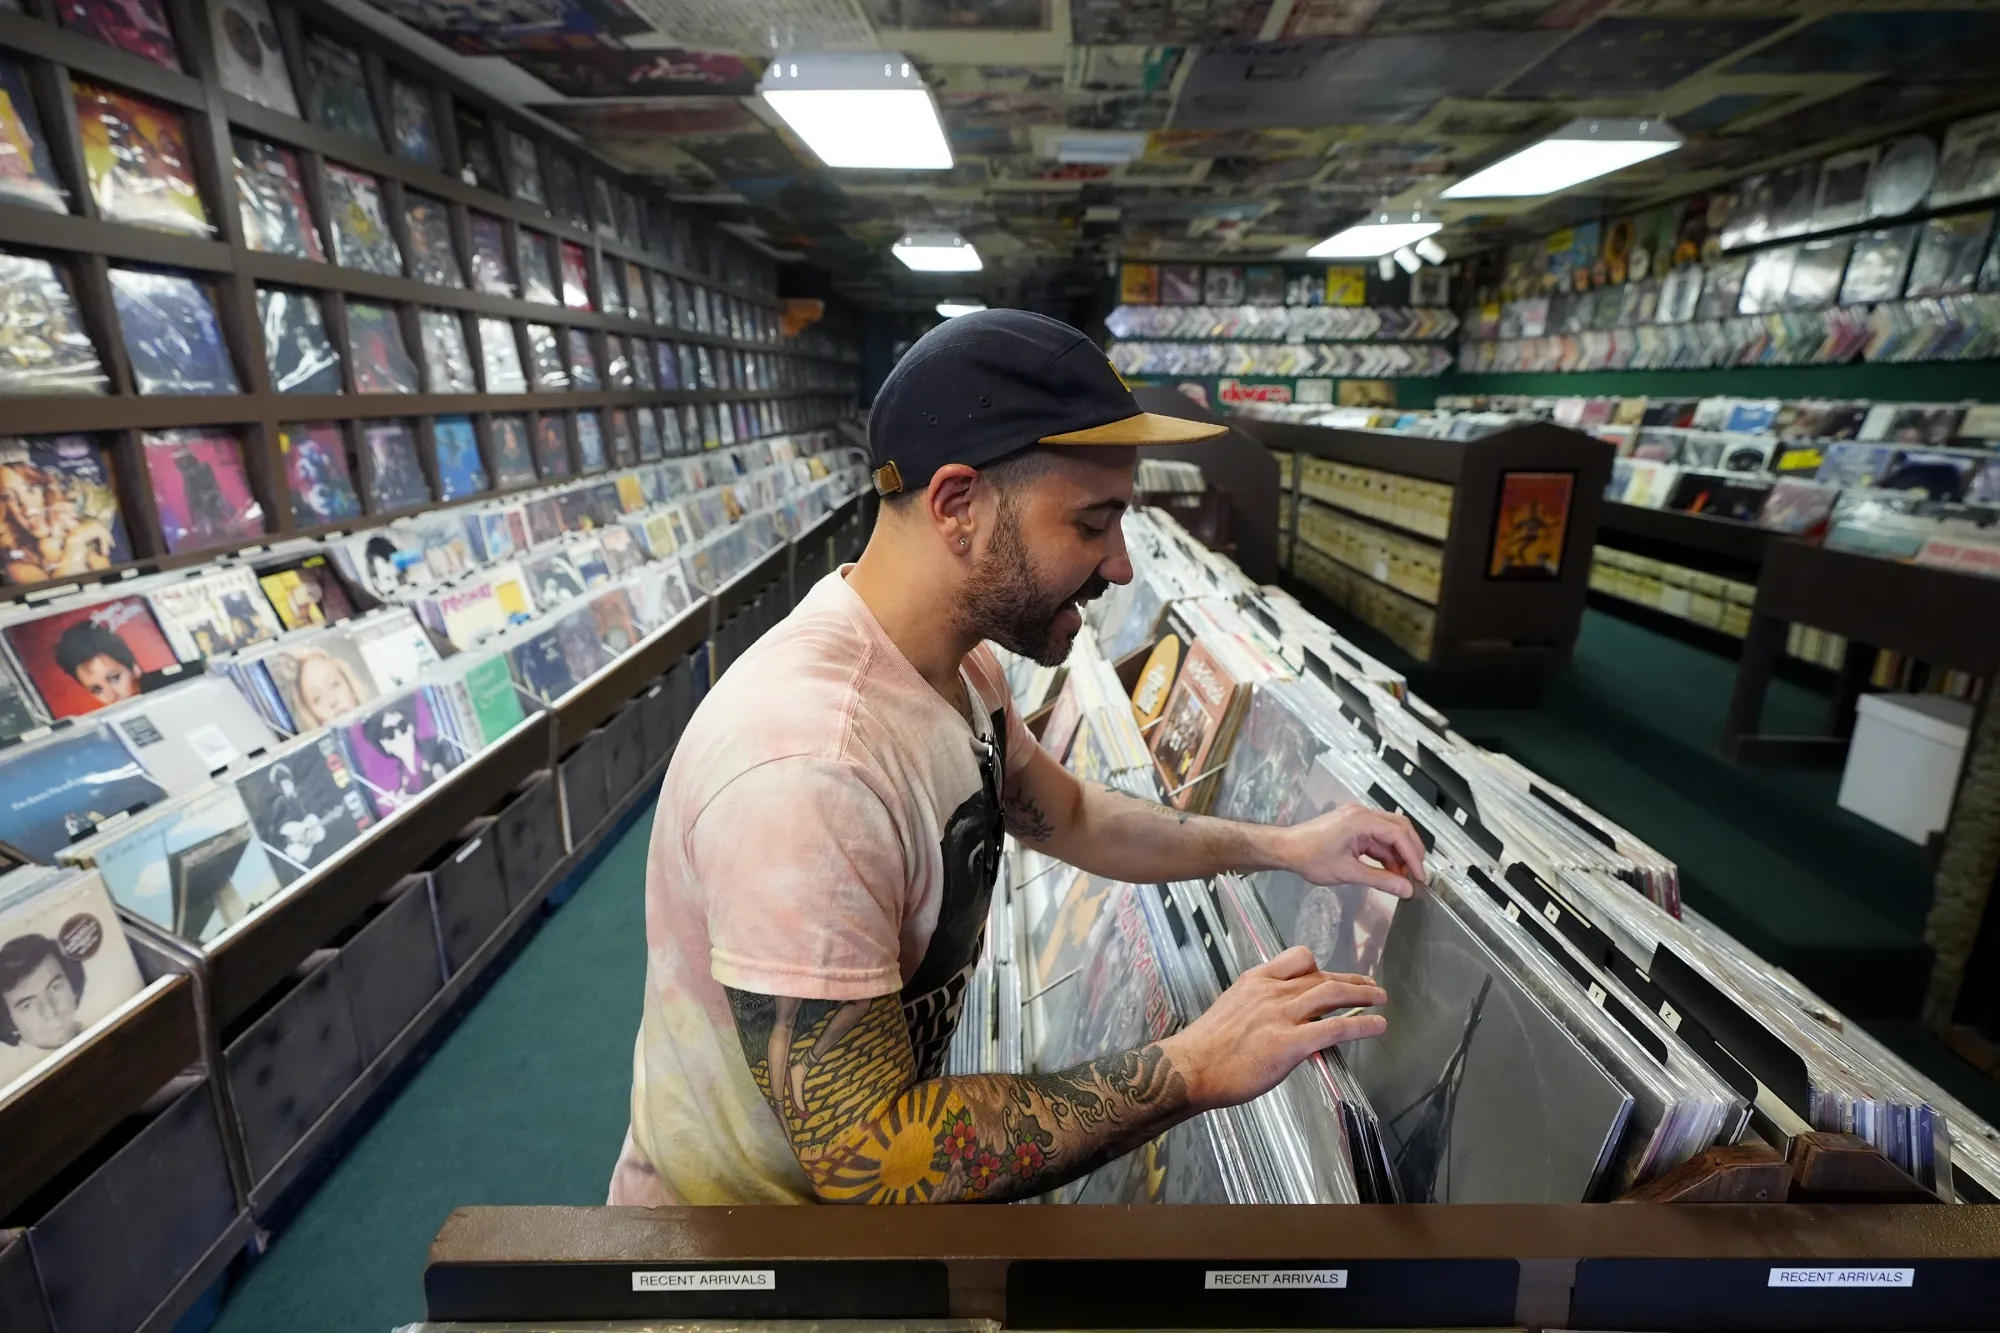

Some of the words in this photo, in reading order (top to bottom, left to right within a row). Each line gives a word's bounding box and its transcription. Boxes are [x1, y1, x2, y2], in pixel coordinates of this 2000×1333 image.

[640, 1275, 695, 1286] RECENT
[699, 1274, 766, 1285] ARRIVALS
[1214, 1274, 1269, 1284] RECENT
[1273, 1273, 1339, 1284] ARRIVALS
[1780, 1272, 1835, 1282] RECENT
[1837, 1272, 1903, 1282] ARRIVALS
